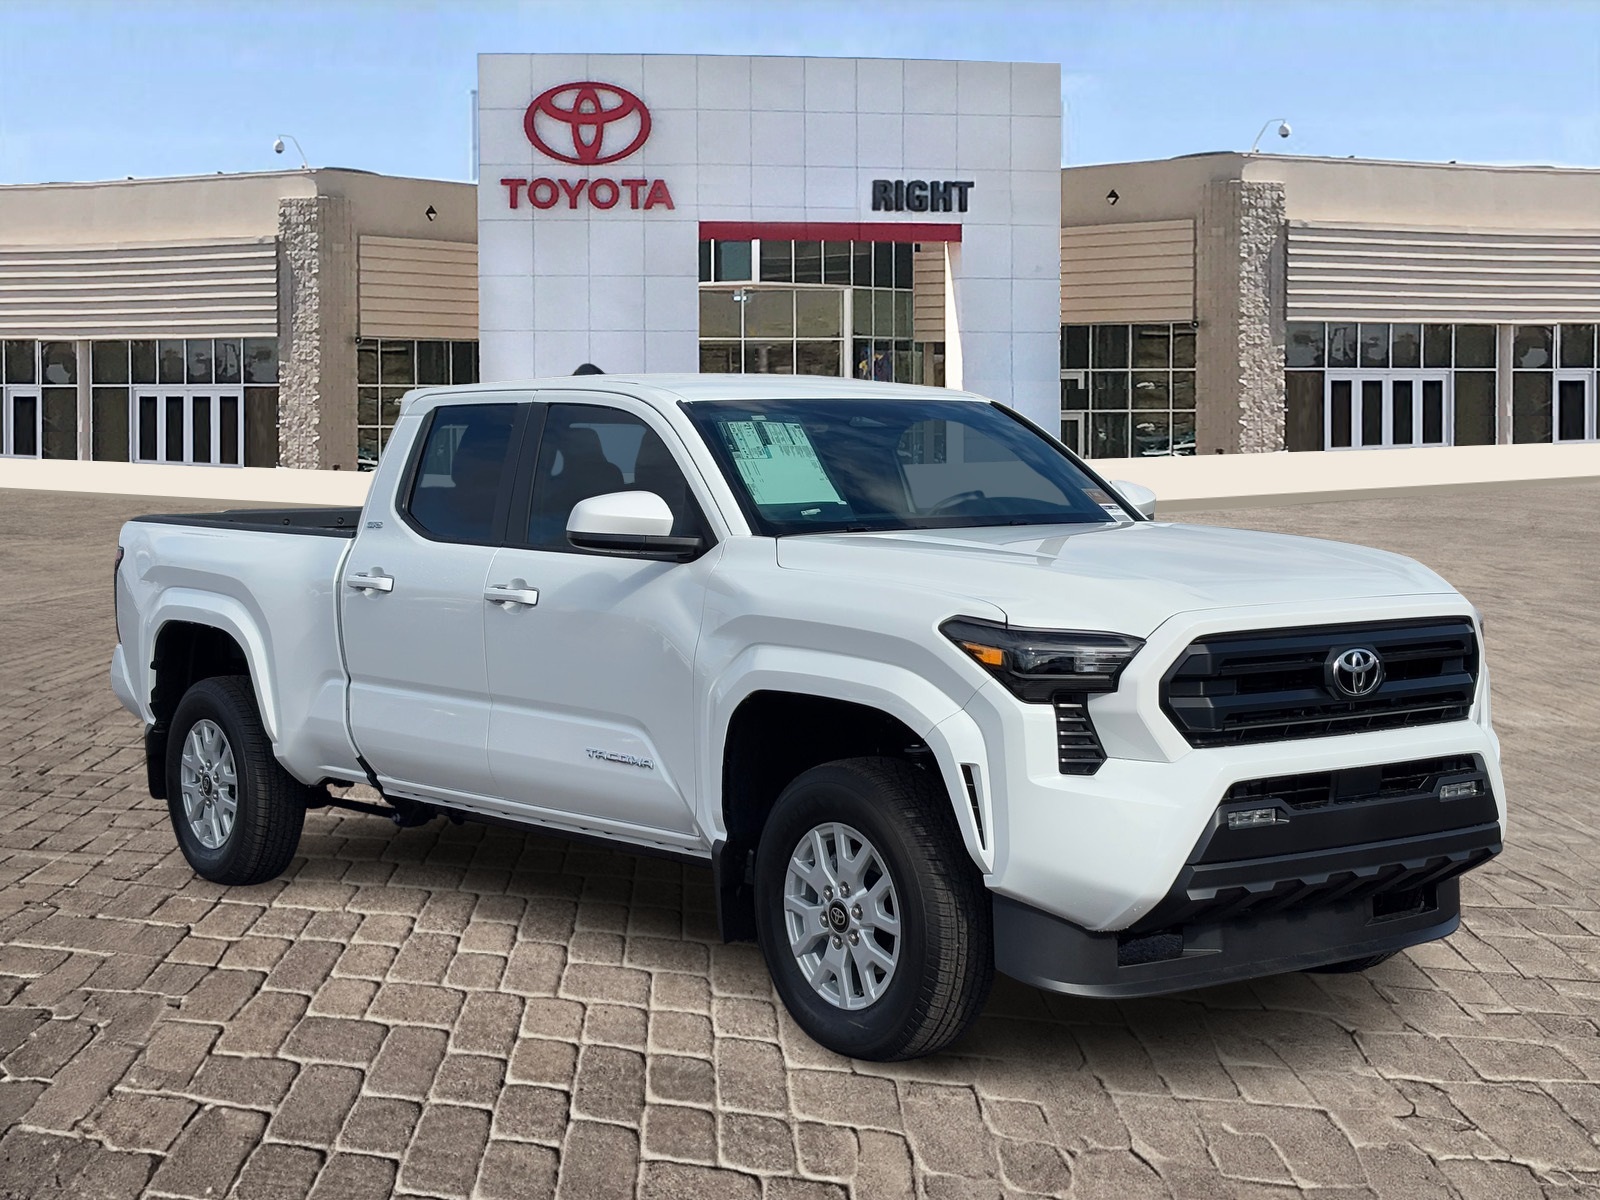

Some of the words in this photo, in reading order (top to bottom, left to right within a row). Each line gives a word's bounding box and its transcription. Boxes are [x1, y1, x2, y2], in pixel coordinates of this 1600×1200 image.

[500, 178, 675, 210] TOYOTA
[872, 179, 975, 212] RIGHT
[585, 748, 655, 770] TACOMA
